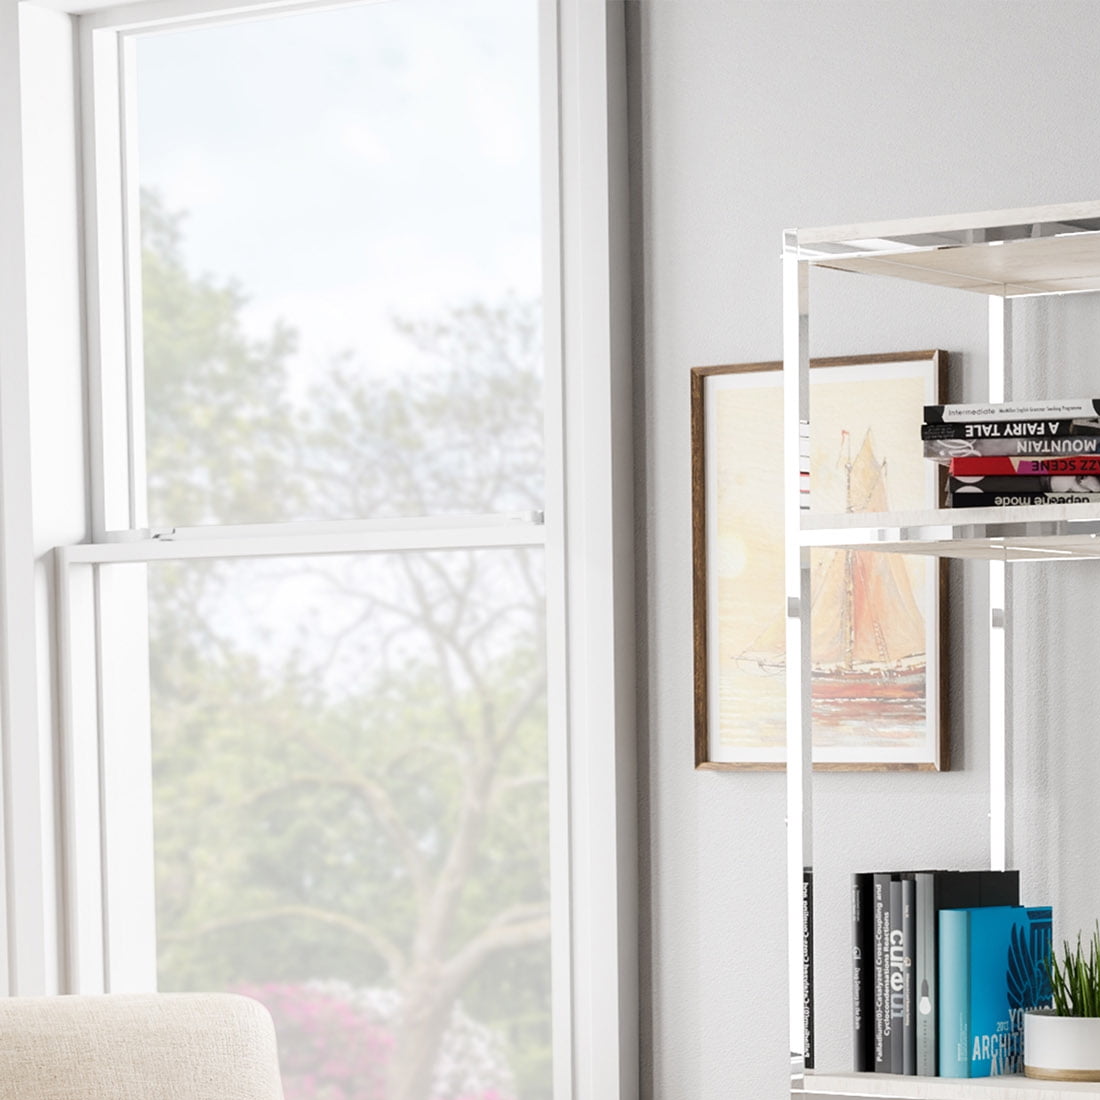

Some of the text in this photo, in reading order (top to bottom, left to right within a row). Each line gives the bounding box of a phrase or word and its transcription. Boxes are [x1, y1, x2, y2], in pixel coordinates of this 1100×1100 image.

[948, 407, 996, 416] Intermediate
[965, 424, 1000, 437] TALE
[1002, 423, 1045, 435] FAIRY
[1048, 422, 1060, 434] A
[1016, 440, 1097, 453] MOUNTAIN
[1032, 460, 1076, 472] SCENE
[994, 496, 1033, 506] mode
[875, 902, 884, 965] Cross-Coupling
[882, 912, 892, 1036] Cyclocondensations Reactions
